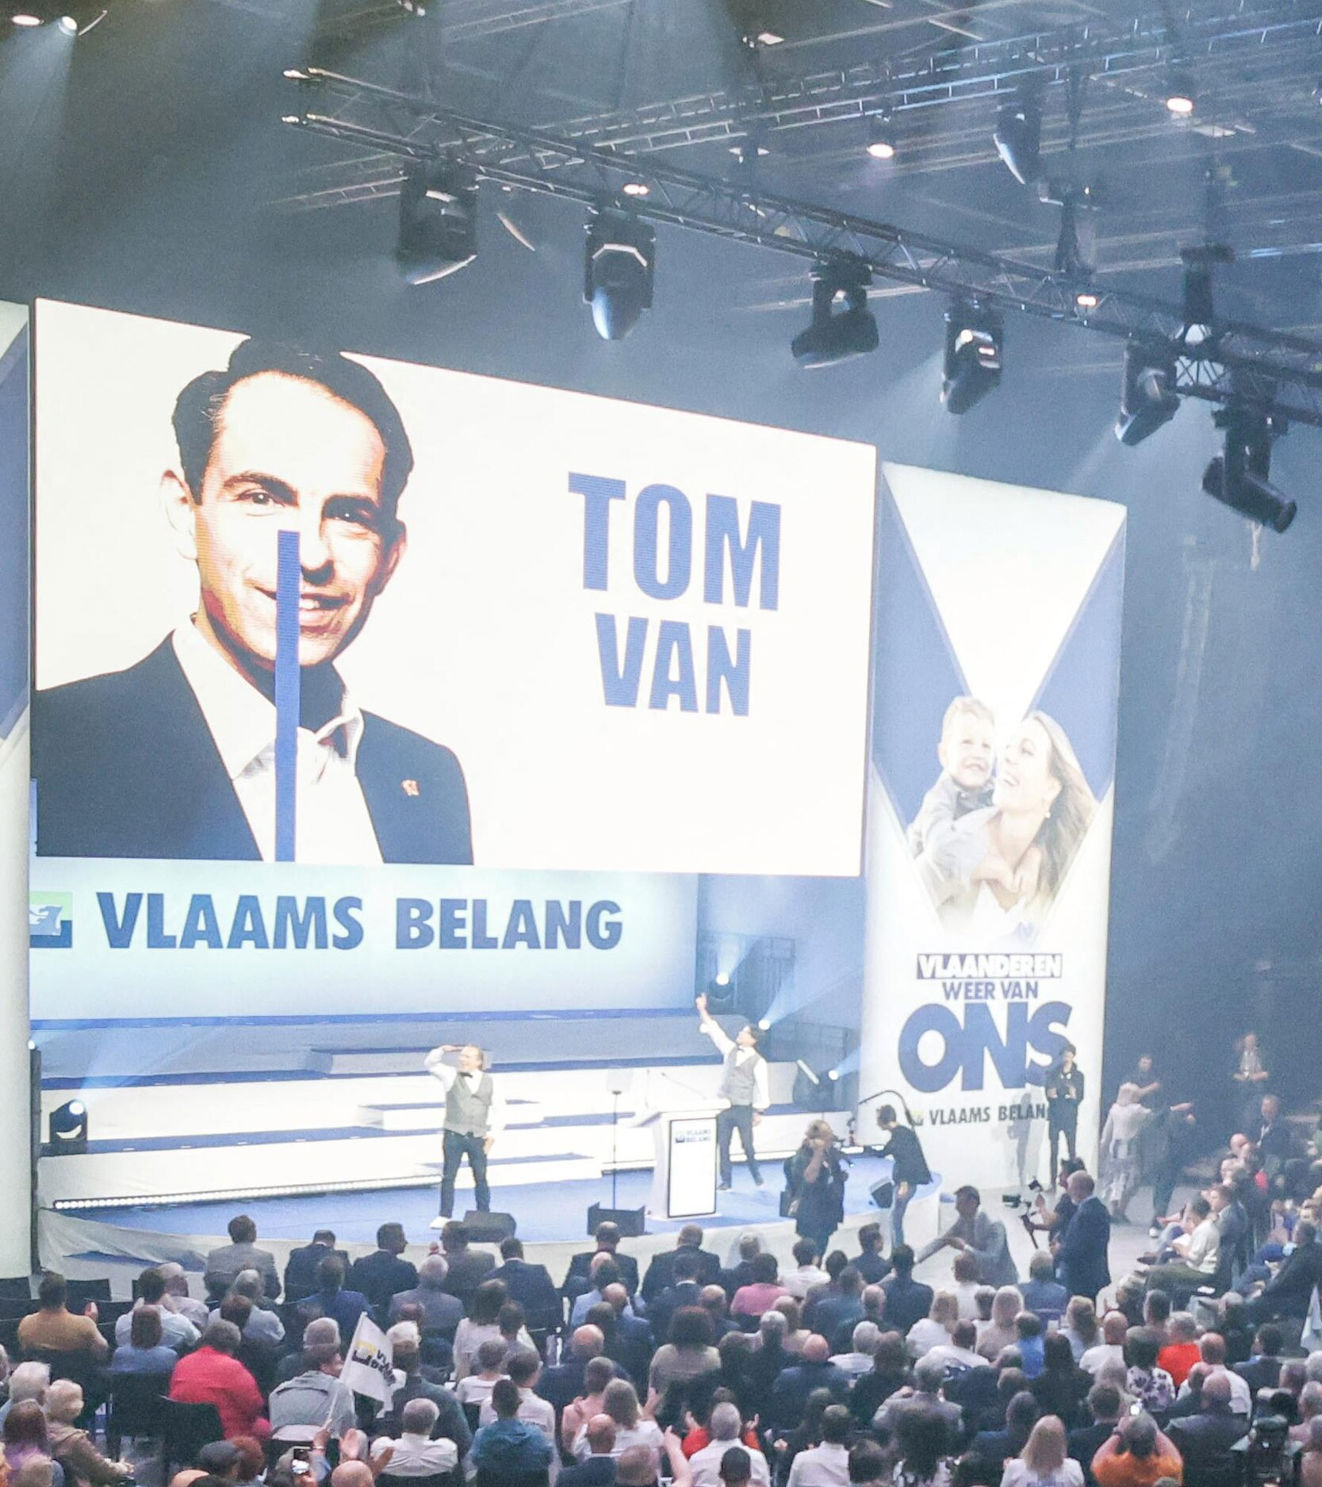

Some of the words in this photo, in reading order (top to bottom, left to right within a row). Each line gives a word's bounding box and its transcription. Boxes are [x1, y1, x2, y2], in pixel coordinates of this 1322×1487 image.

[567, 471, 782, 612] TOM
[594, 612, 752, 718] VAN
[96, 891, 365, 950] VLAAMS
[395, 897, 624, 950] BELANG
[917, 953, 1062, 979] VLAANDEREN
[942, 981, 996, 1000] WEER
[1000, 980, 1039, 999] VAN
[898, 1001, 1073, 1093] ONS
[929, 1106, 991, 1127] VLAAMS
[998, 1103, 1050, 1122] BELAN
